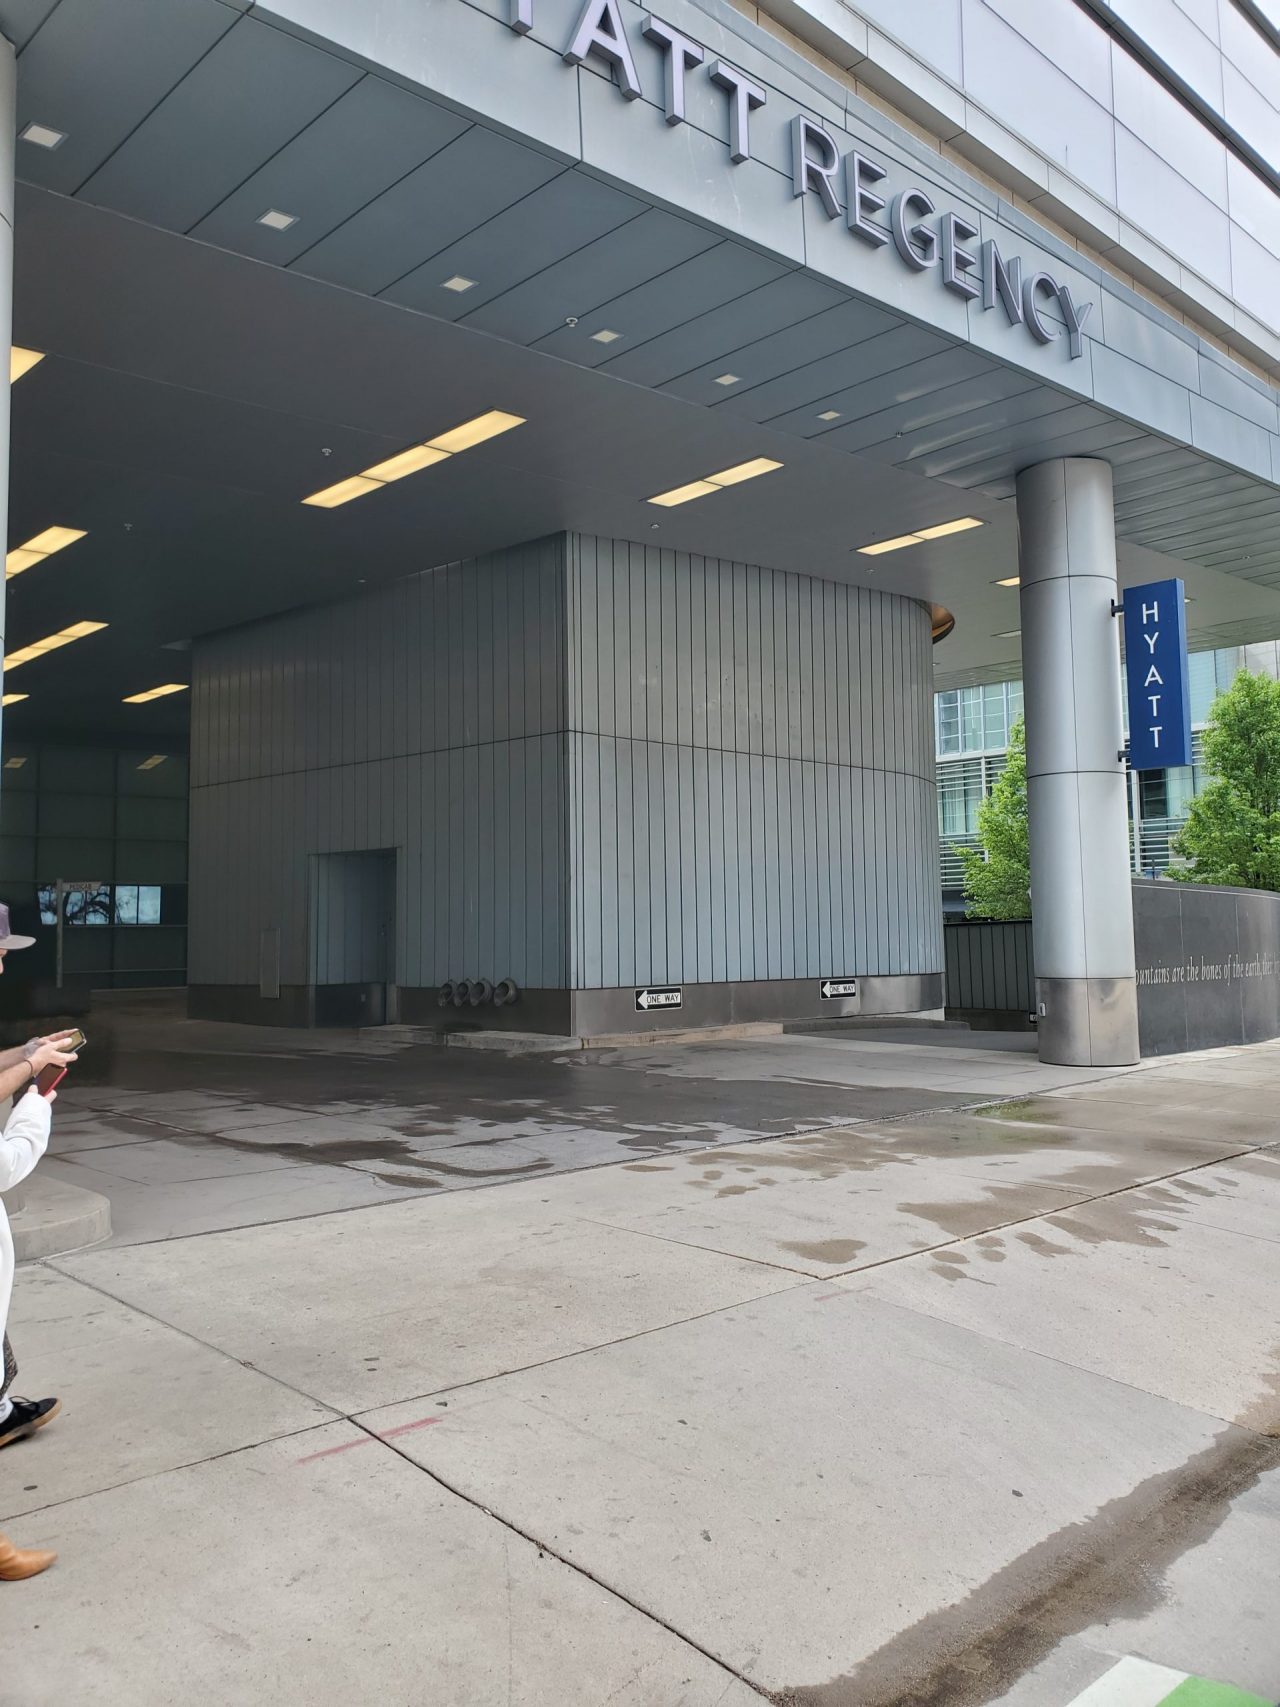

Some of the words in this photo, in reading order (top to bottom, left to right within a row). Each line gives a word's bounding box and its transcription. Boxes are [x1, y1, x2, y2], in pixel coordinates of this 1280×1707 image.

[792, 114, 1093, 360] REGENCY
[1142, 601, 1163, 748] HYATT
[1172, 965, 1185, 983] are
[1187, 956, 1199, 981] the
[1201, 955, 1222, 980] bones
[1224, 954, 1232, 987] of
[1233, 954, 1244, 978] the
[646, 994, 661, 1004] ONE
[665, 993, 679, 1002] WAY
[831, 985, 841, 993] ONE
